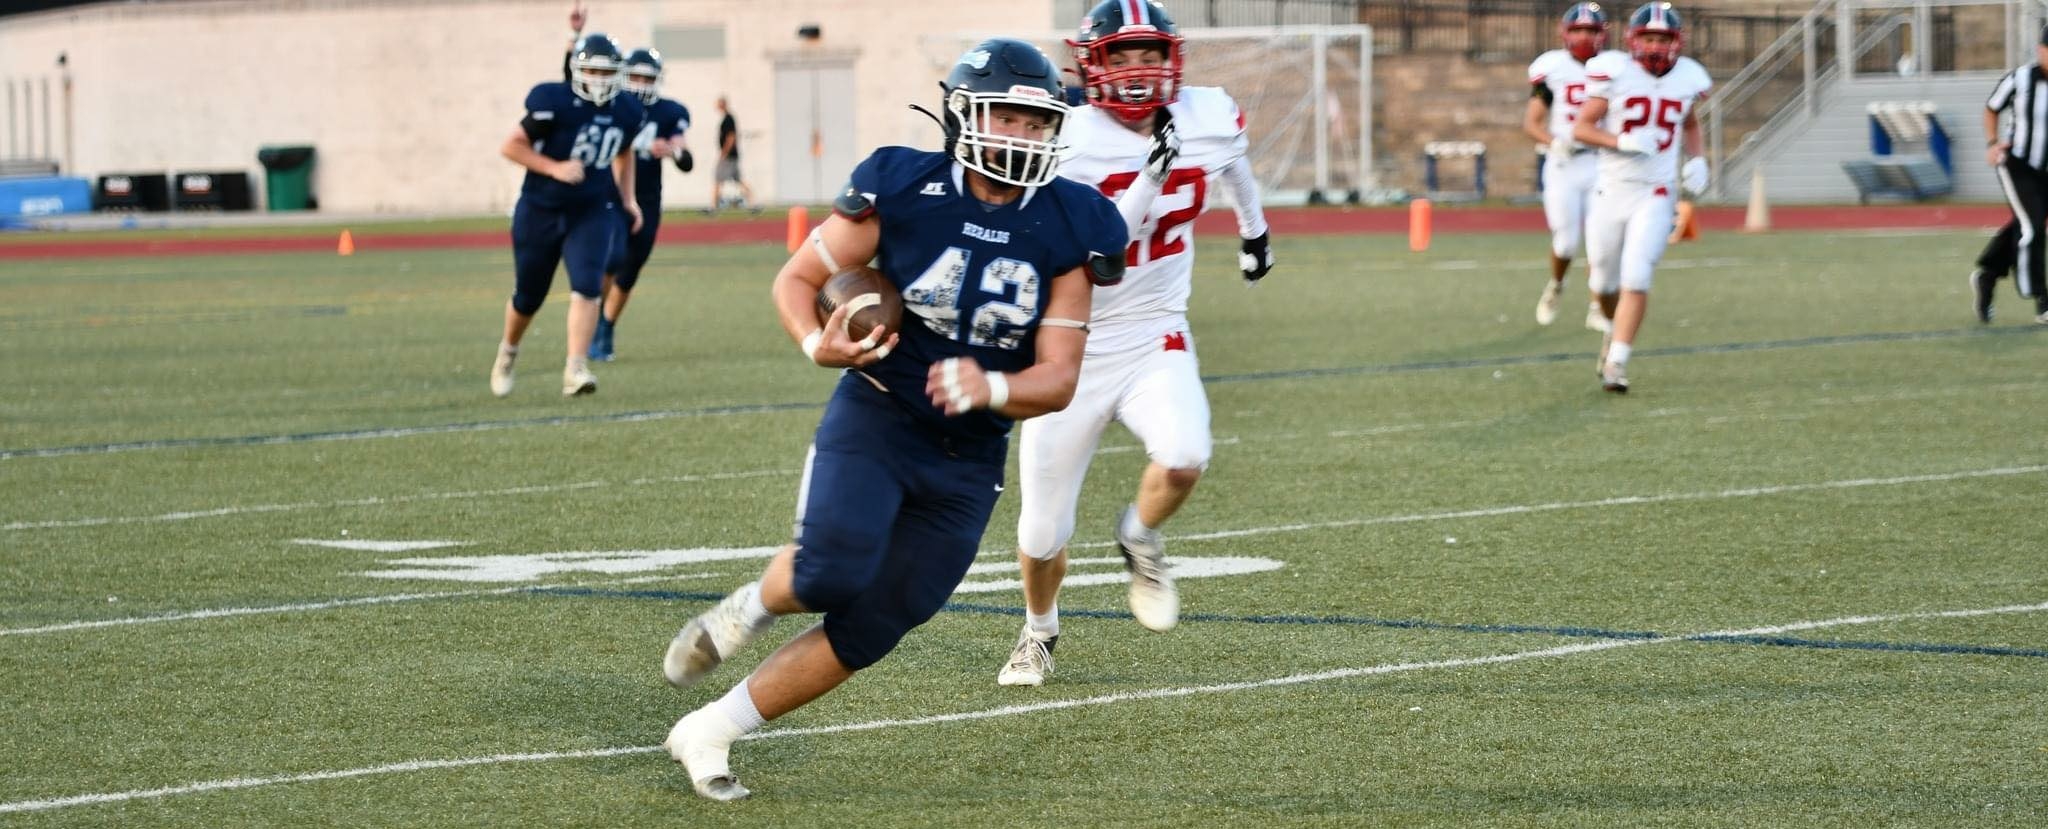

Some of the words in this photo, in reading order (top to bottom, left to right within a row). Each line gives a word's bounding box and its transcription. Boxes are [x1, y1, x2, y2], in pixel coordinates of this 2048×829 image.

[571, 124, 624, 169] 60
[1621, 96, 1682, 152] 25
[961, 221, 1010, 244] HERALDS
[902, 245, 1040, 350] 42
